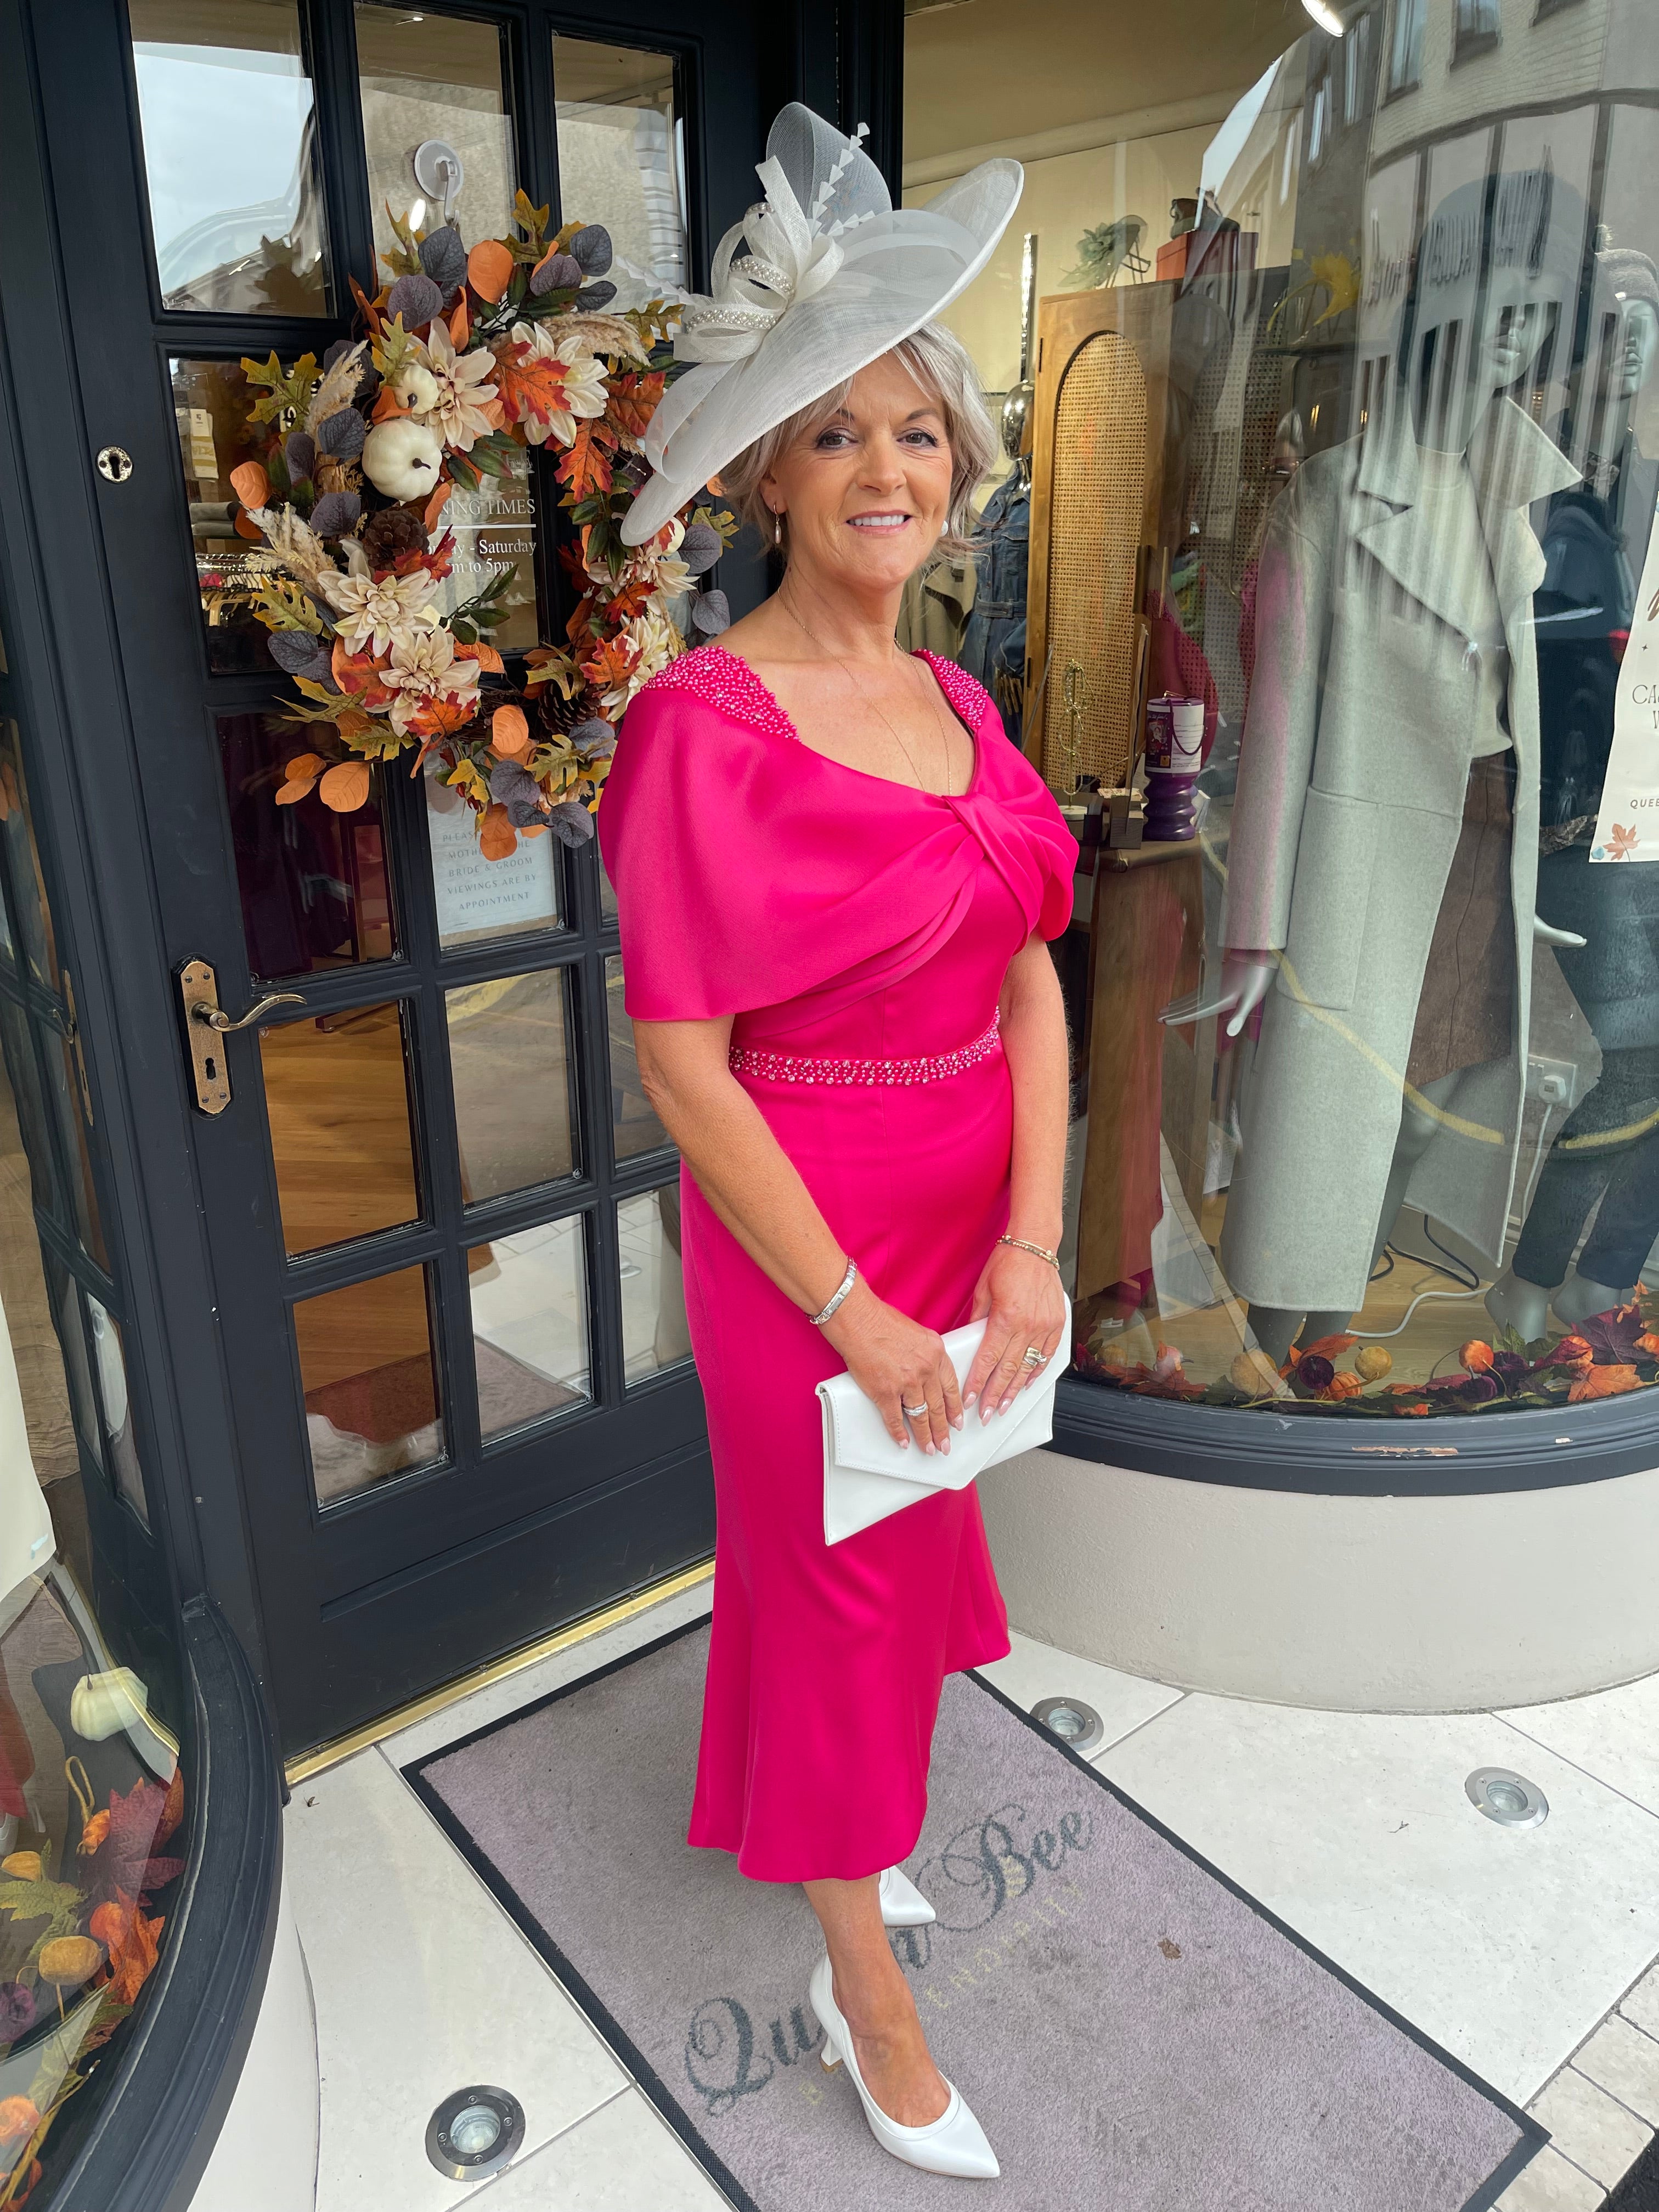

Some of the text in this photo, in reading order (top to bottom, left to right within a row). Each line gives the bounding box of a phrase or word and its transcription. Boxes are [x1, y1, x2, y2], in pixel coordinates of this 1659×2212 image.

[487, 499, 535, 515] TIMES
[479, 538, 537, 556] Saturday
[469, 561, 482, 572] to
[486, 557, 514, 575] 5pm
[443, 831, 475, 842] PLEAS
[518, 840, 531, 848] HE
[449, 865, 479, 877] BRIDE
[496, 857, 533, 870] GROOM
[447, 873, 537, 895] VIEWINGS ARE BY
[459, 891, 529, 910] APPOINTMENT
[915, 1803, 1094, 1932] Bee
